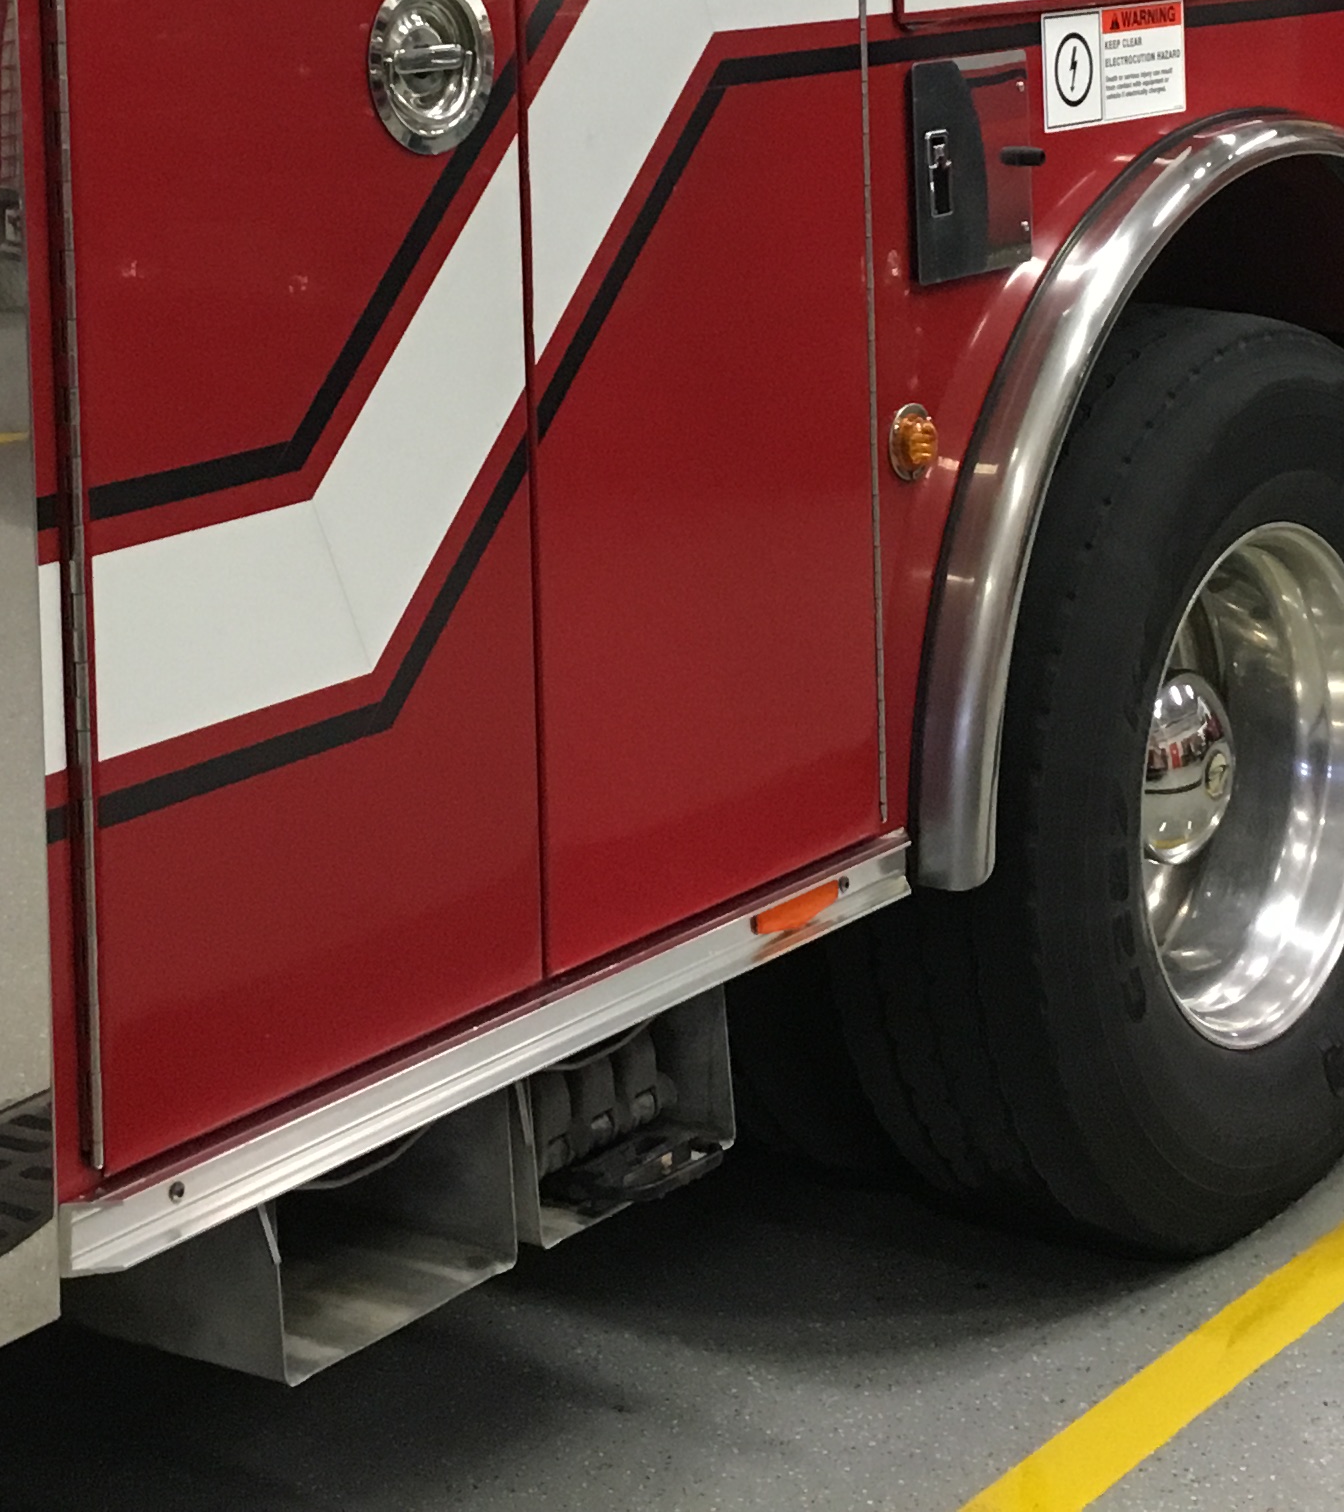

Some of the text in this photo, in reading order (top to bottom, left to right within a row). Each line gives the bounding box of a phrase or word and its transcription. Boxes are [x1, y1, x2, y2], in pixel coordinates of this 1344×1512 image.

[1121, 6, 1176, 28] WARNING
[1105, 36, 1142, 50] KEEP CLEAR
[1105, 49, 1180, 68] ELECTROCUTION HAZARD
